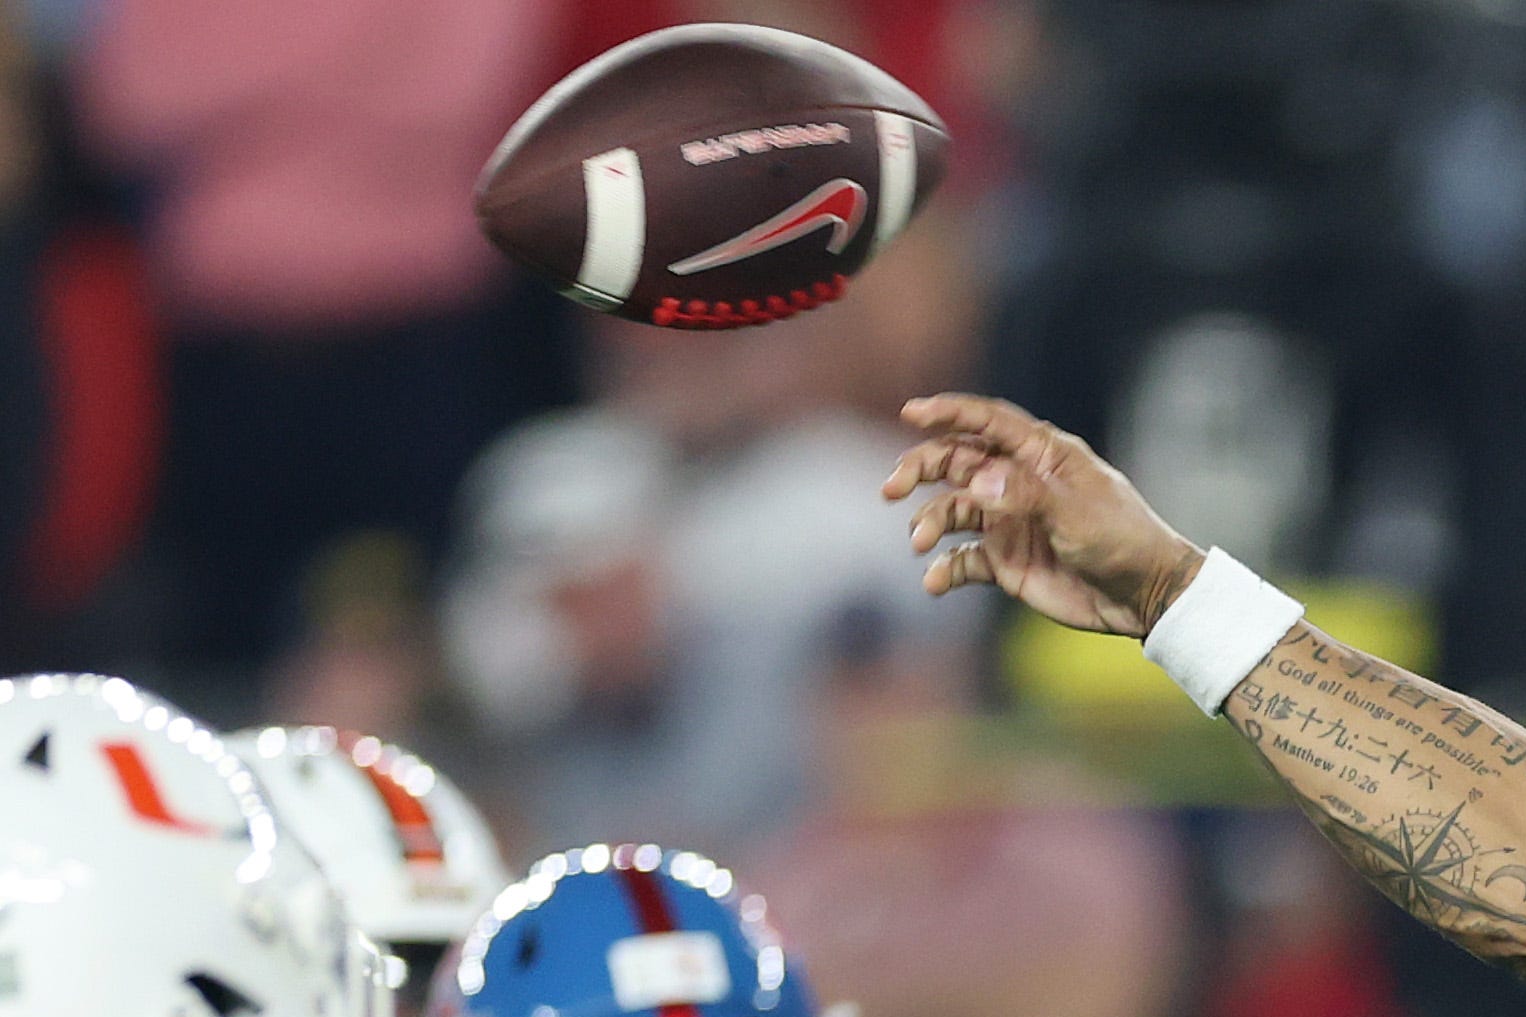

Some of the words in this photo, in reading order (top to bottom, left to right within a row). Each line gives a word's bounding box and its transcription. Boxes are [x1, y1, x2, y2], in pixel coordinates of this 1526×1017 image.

[1278, 659, 1318, 686] God
[1317, 680, 1343, 697] all
[1343, 690, 1395, 721] things
[1395, 715, 1424, 736] are
[1273, 734, 1335, 773] Matthew
[1338, 765, 1381, 795] 19:26
